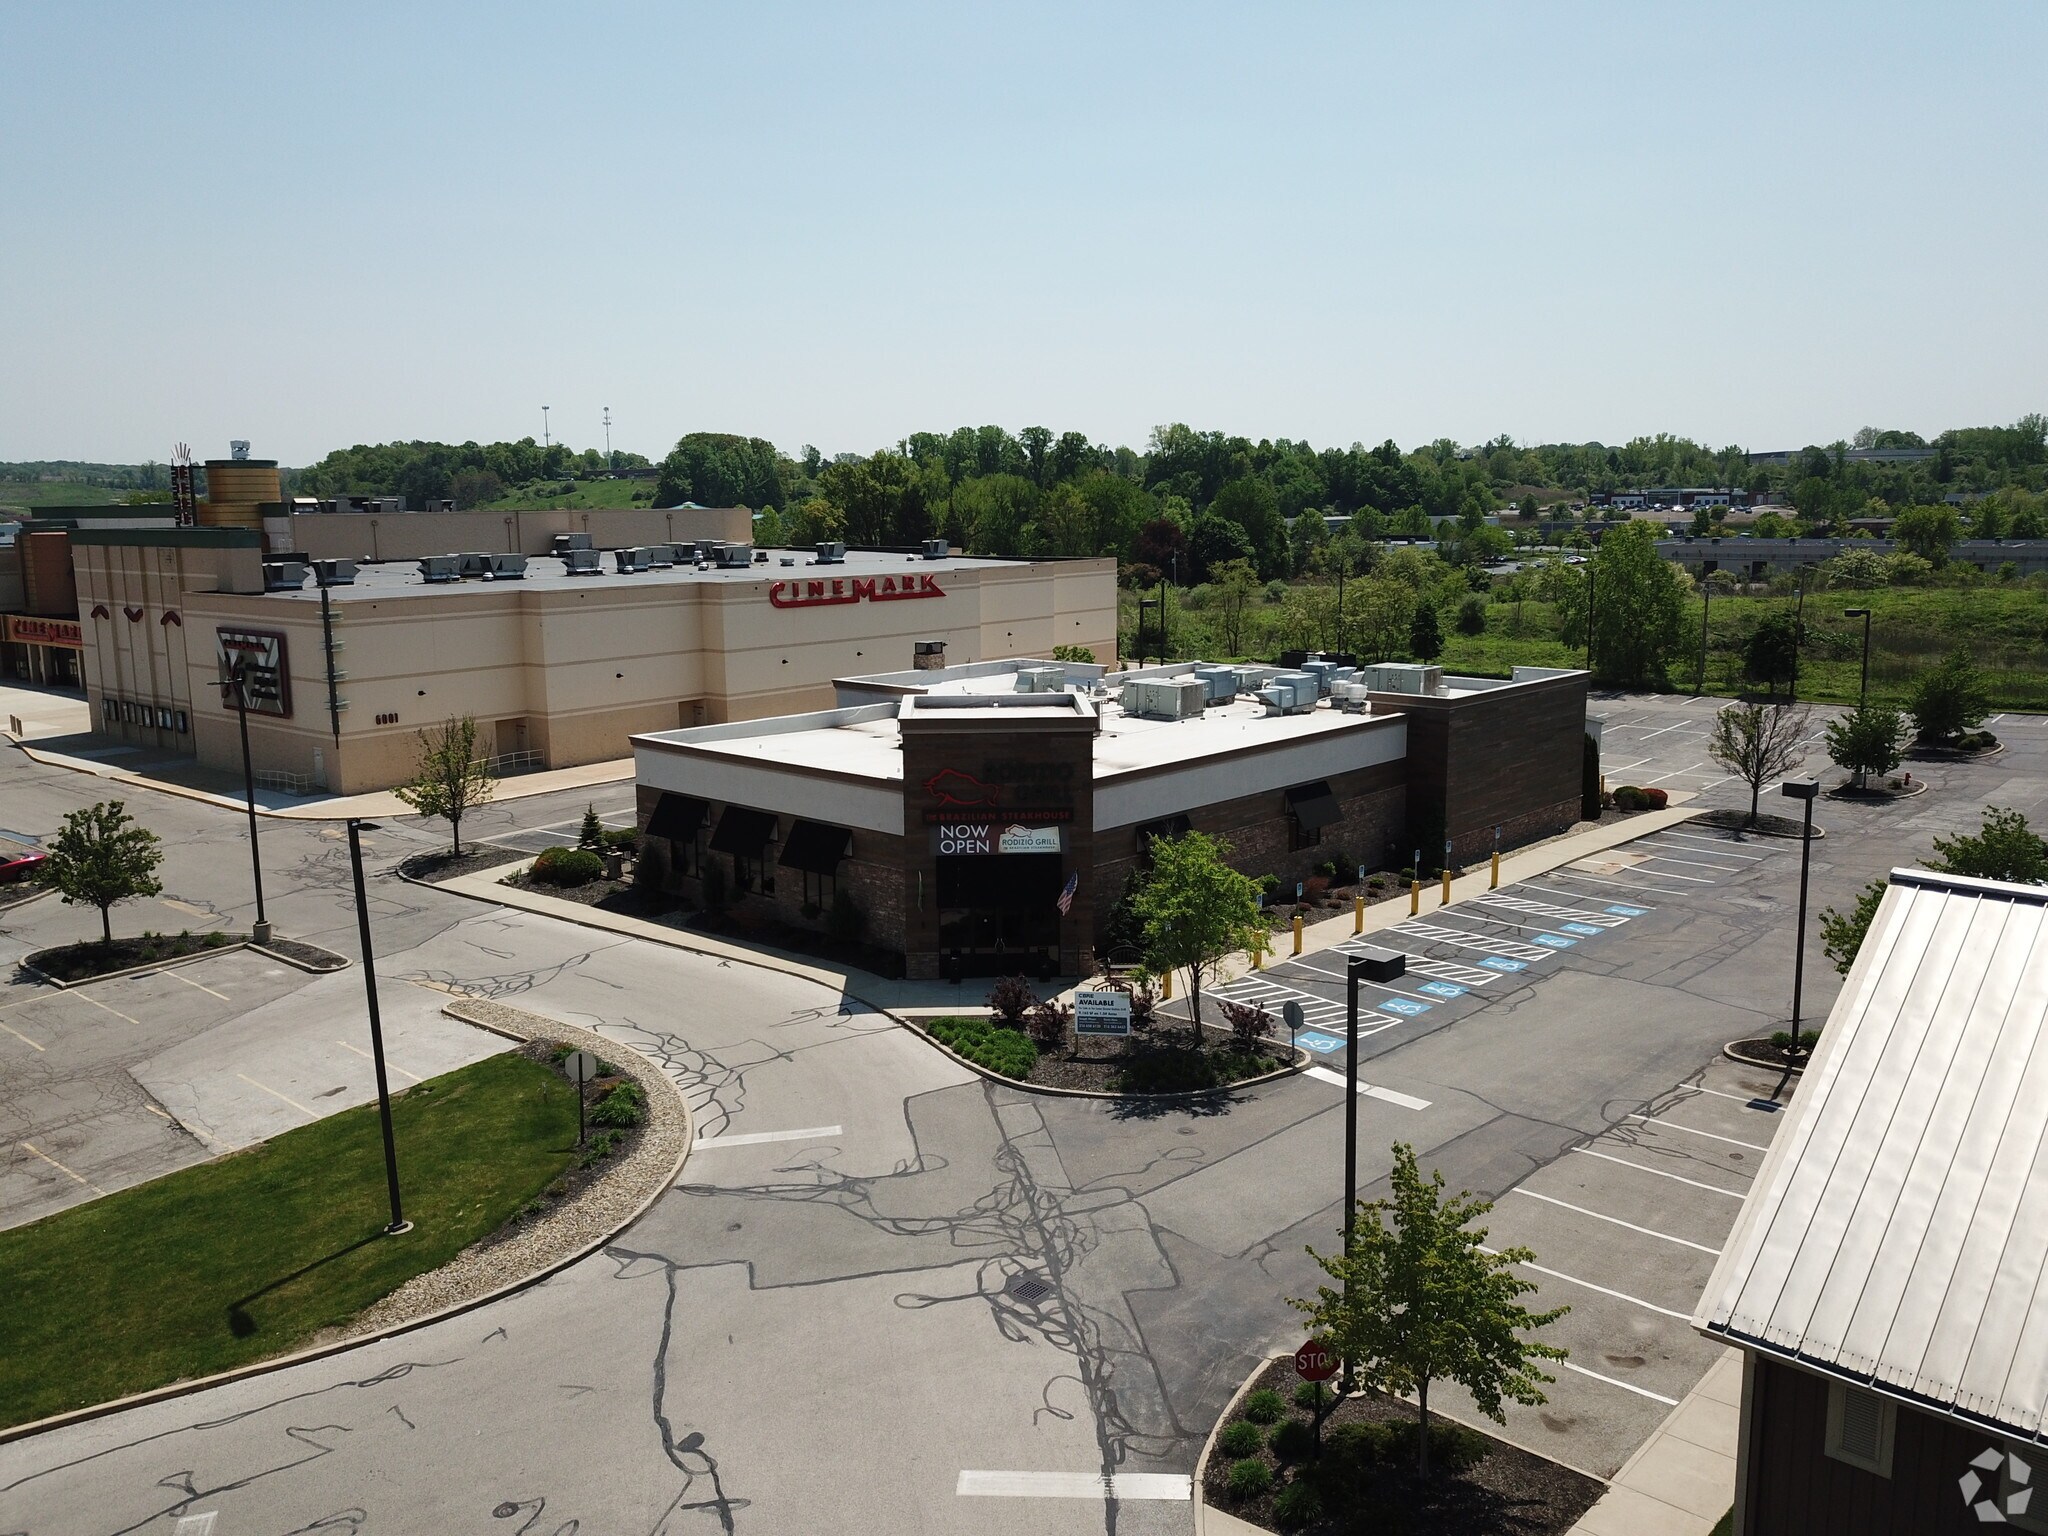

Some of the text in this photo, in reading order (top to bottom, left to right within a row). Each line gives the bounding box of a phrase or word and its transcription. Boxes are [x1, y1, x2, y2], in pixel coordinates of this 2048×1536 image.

[770, 574, 947, 608] CINEMARK
[13, 618, 83, 646] CINEMAR
[939, 813, 997, 822] BRAZILIAN
[1002, 811, 1070, 821] STEAKHOUSE
[940, 824, 989, 839] NOW
[940, 839, 990, 854] OPEN
[1002, 838, 1057, 846] RODIZIO GRILL
[1297, 1352, 1328, 1370] STO
